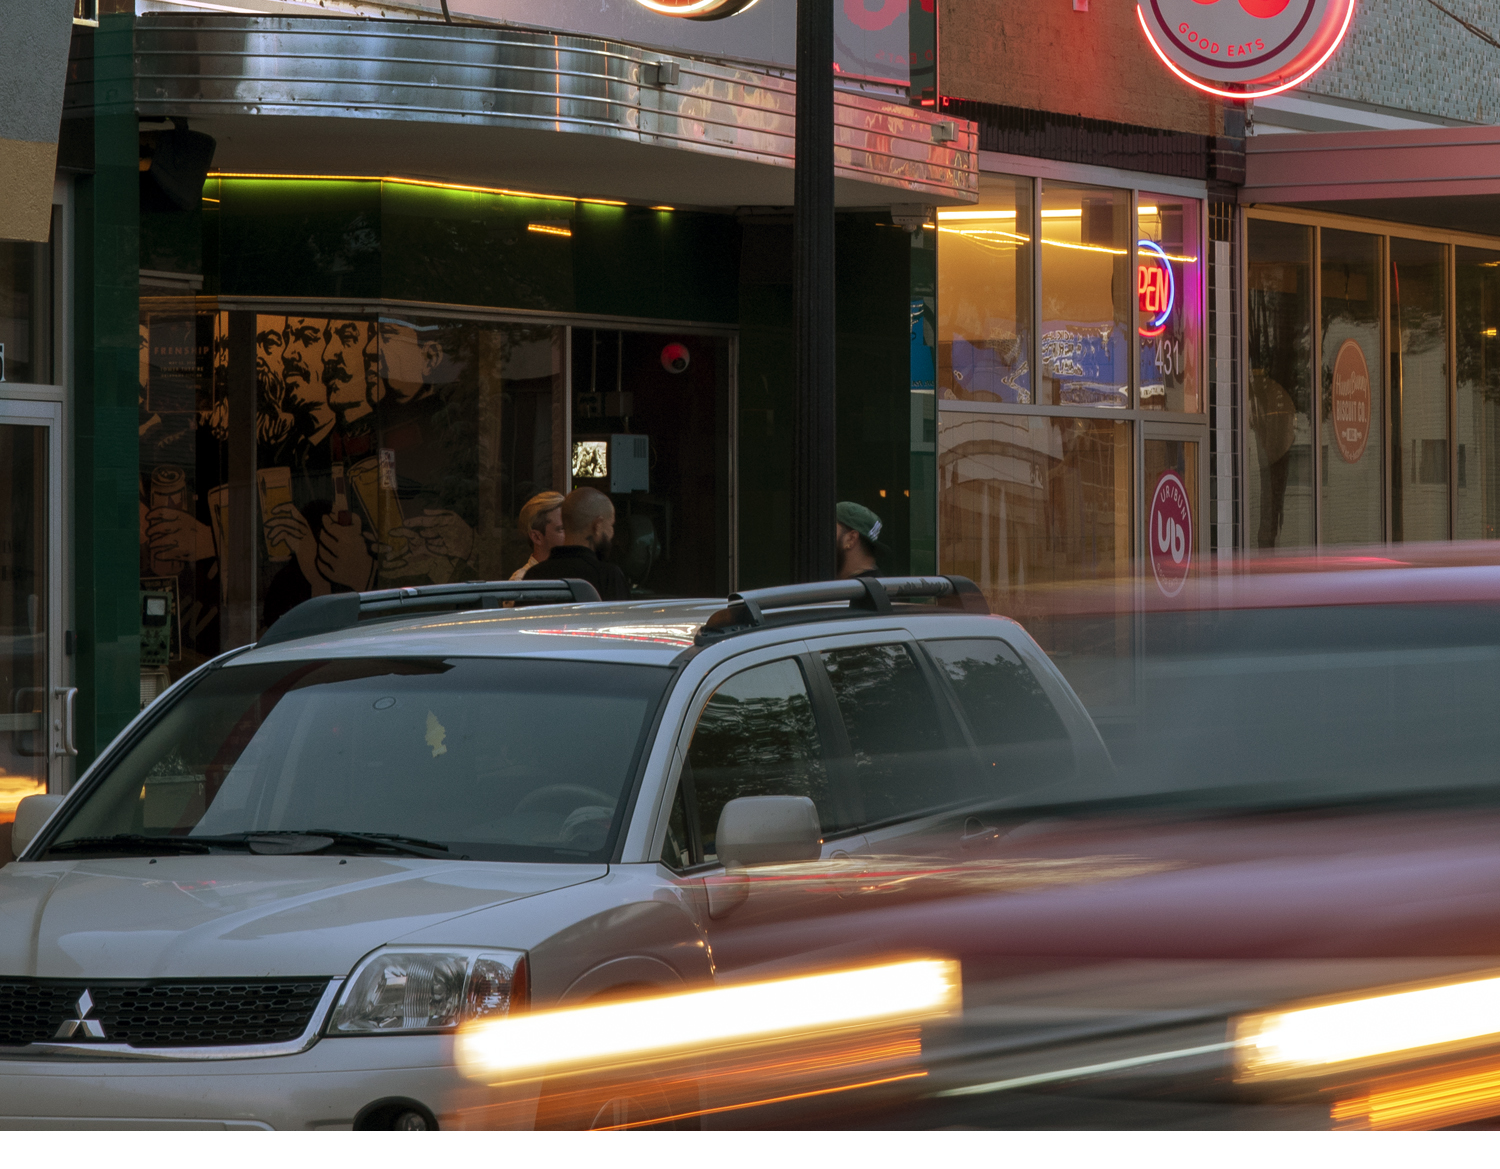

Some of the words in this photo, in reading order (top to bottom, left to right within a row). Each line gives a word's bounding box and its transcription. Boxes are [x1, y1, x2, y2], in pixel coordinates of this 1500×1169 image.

[1178, 22, 1220, 54] GOOD
[1227, 38, 1266, 57] EATS
[1155, 339, 1179, 375] 431
[1160, 485, 1187, 521] UR/BUN
